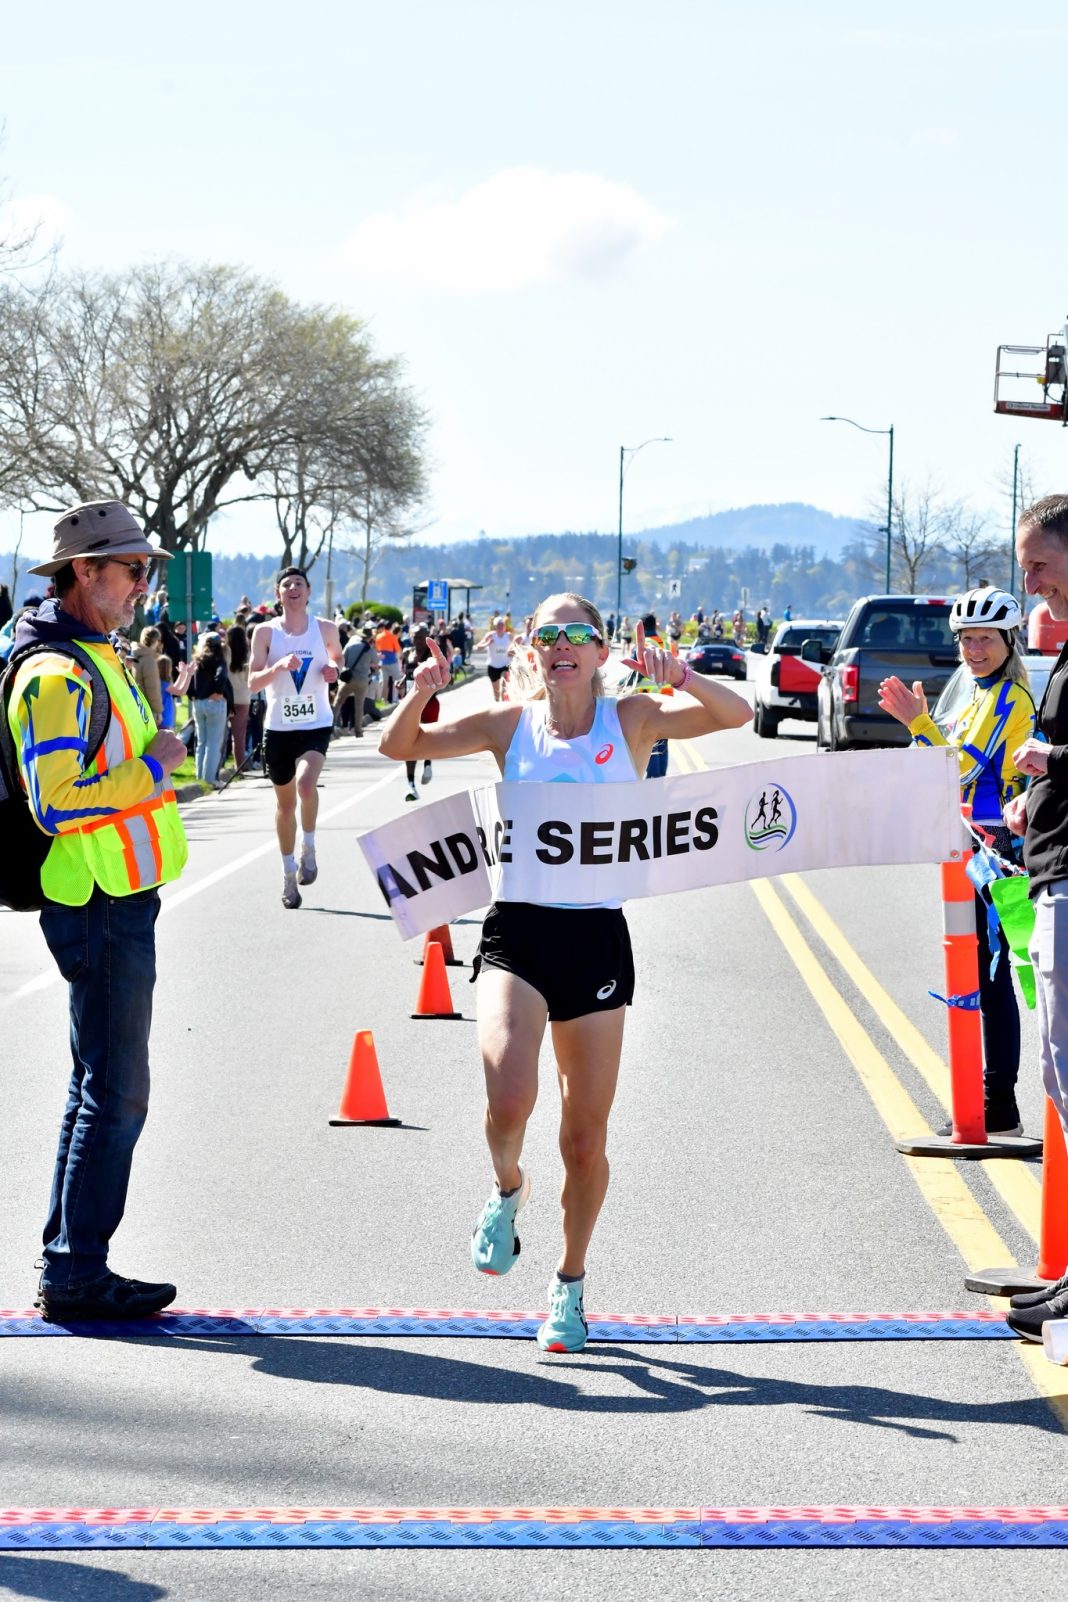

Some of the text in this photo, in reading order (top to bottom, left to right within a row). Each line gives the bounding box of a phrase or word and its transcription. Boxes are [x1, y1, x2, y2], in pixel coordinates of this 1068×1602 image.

[283, 703, 314, 718] 3544
[475, 819, 514, 868] RCE
[535, 806, 719, 866] SERIES
